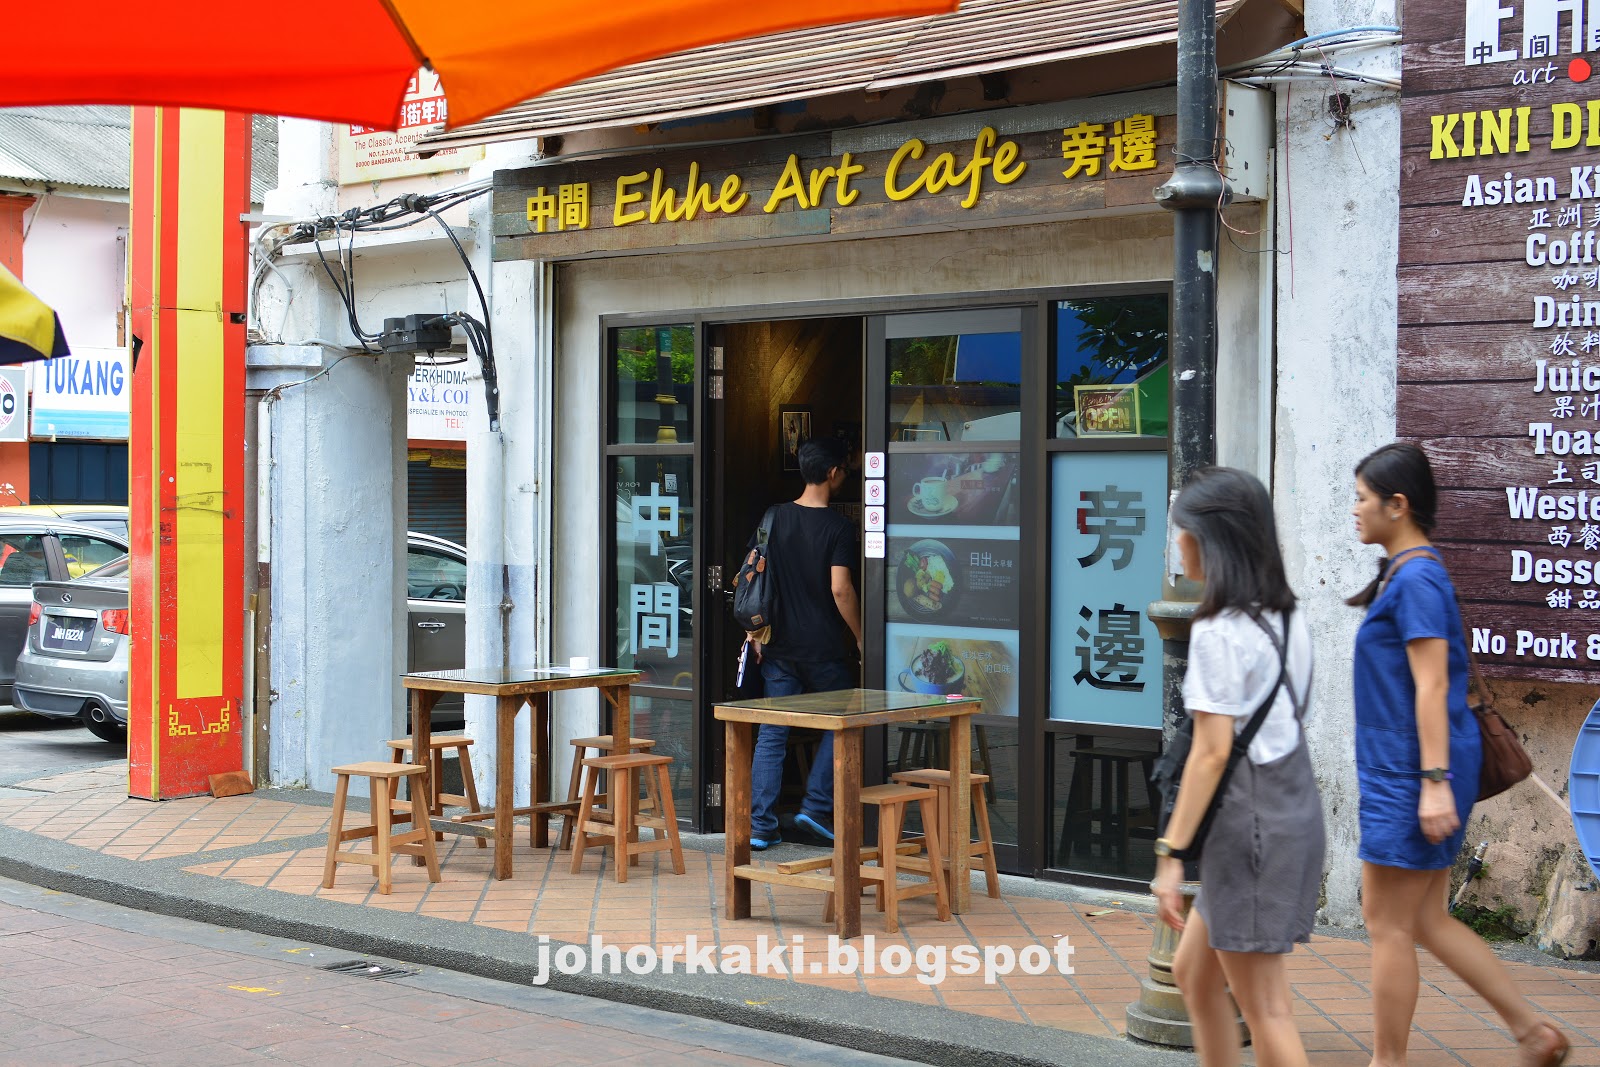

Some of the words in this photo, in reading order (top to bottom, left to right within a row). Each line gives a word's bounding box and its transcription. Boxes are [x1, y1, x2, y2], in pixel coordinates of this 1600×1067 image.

[1465, 0, 1600, 66] EH
[1513, 62, 1558, 86] art
[355, 141, 366, 150] The
[368, 137, 393, 149] Classic
[395, 132, 422, 145] Accents
[1061, 113, 1158, 180] 旁邊
[1430, 106, 1531, 160] KINI
[433, 148, 458, 157] ALAYSIA
[614, 162, 748, 226] Ehhe
[763, 152, 864, 213] Art
[884, 126, 1027, 209] Cafe
[1462, 174, 1556, 207] Asian
[527, 182, 591, 232] 中間
[1526, 231, 1600, 266] Coff
[44, 359, 124, 396] TUKANG
[1533, 360, 1600, 393] Juic
[409, 387, 440, 403] Y&L
[1549, 394, 1600, 420] 果汁
[1085, 407, 1131, 430] OPEN
[630, 482, 679, 659] 中間
[970, 551, 992, 568] 日出
[1073, 485, 1146, 693] 旁邊
[1545, 588, 1600, 610] 甜品
[1471, 627, 1506, 655] No
[1516, 629, 1577, 659] Pork
